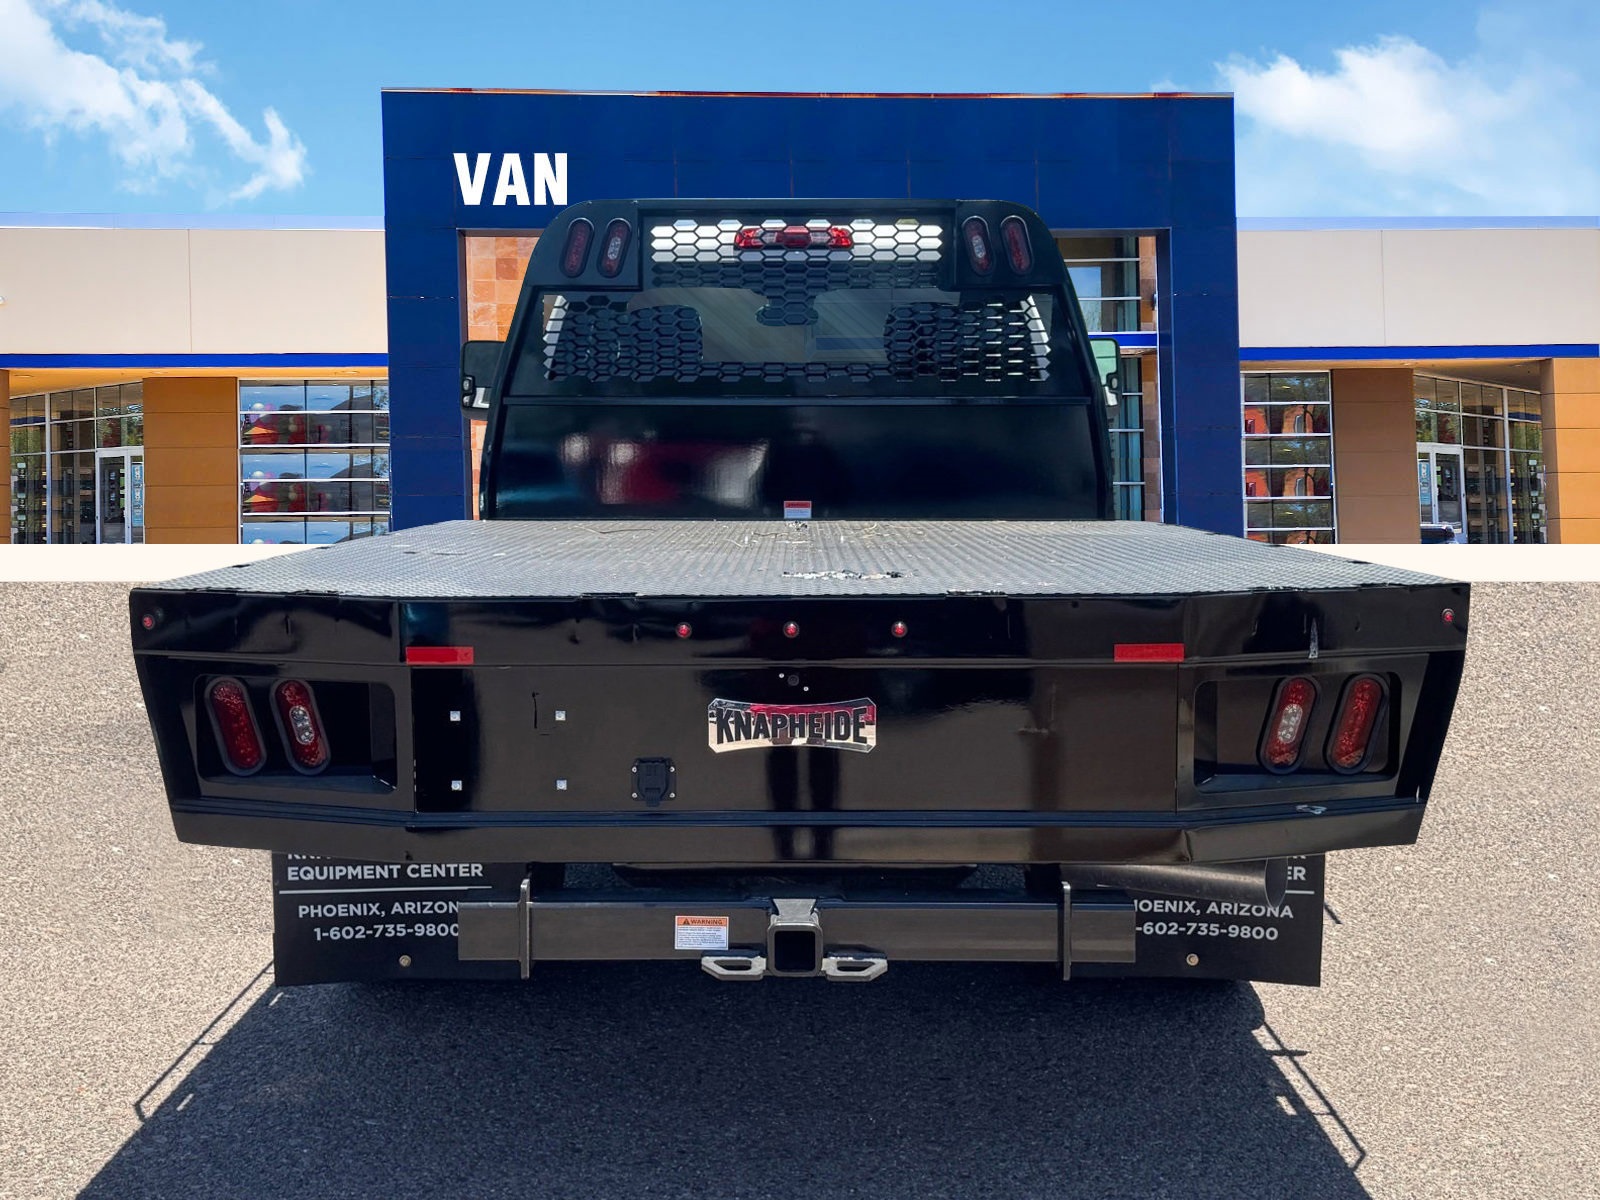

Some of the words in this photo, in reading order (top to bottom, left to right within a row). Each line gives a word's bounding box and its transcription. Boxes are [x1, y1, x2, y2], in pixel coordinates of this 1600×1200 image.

[453, 153, 568, 206] VAN
[716, 706, 868, 745] KNAPHEIDE
[287, 865, 402, 881] EQUIPMENT
[407, 863, 484, 879] CENTER
[298, 903, 386, 919] PHOENIX,
[391, 901, 459, 915] ARIZON
[1133, 899, 1201, 916] OENIX,
[1206, 901, 1294, 919] ARIZONA
[1135, 922, 1279, 941] -602-735-9800
